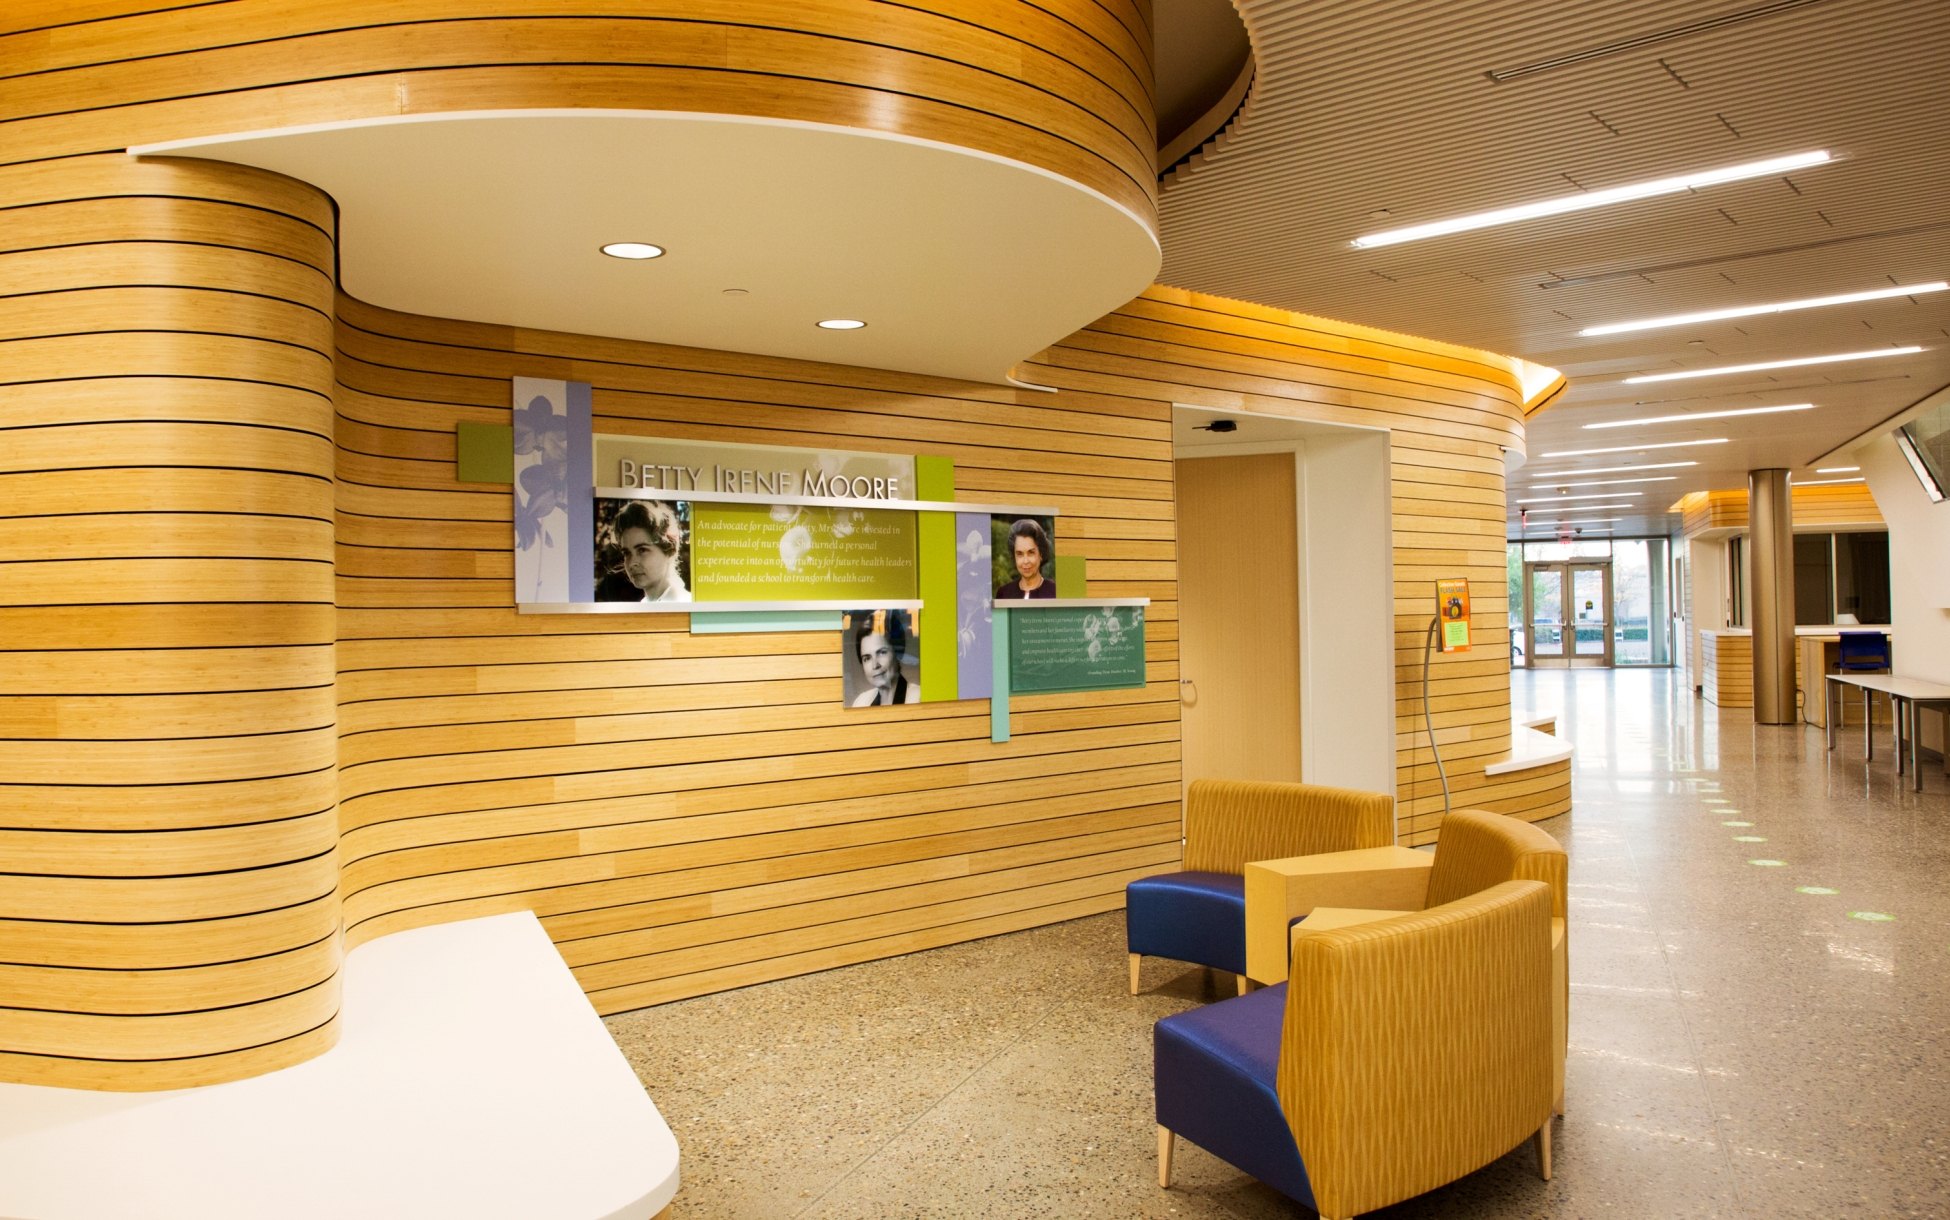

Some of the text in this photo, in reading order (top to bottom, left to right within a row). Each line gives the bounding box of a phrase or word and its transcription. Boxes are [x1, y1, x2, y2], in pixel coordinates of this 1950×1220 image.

[620, 459, 898, 500] BETTY IRENE MOORE
[698, 520, 710, 529] An
[712, 520, 748, 531] advocate
[748, 521, 760, 532] for
[762, 522, 790, 534] patient
[862, 526, 890, 534] invested
[892, 526, 900, 534] in
[698, 538, 712, 547] the
[714, 539, 750, 549] potential
[752, 540, 760, 550] of
[812, 541, 838, 549] turned
[846, 542, 876, 551] personal
[698, 557, 744, 568] experience
[746, 557, 762, 565] into
[822, 557, 834, 568] for
[834, 557, 860, 568] future
[860, 558, 884, 566] health
[886, 558, 912, 567] leaders
[698, 573, 714, 582] and
[714, 573, 750, 584] founded
[750, 574, 756, 582] a
[758, 573, 782, 582] school
[792, 573, 830, 584] transform
[832, 573, 856, 582] health
